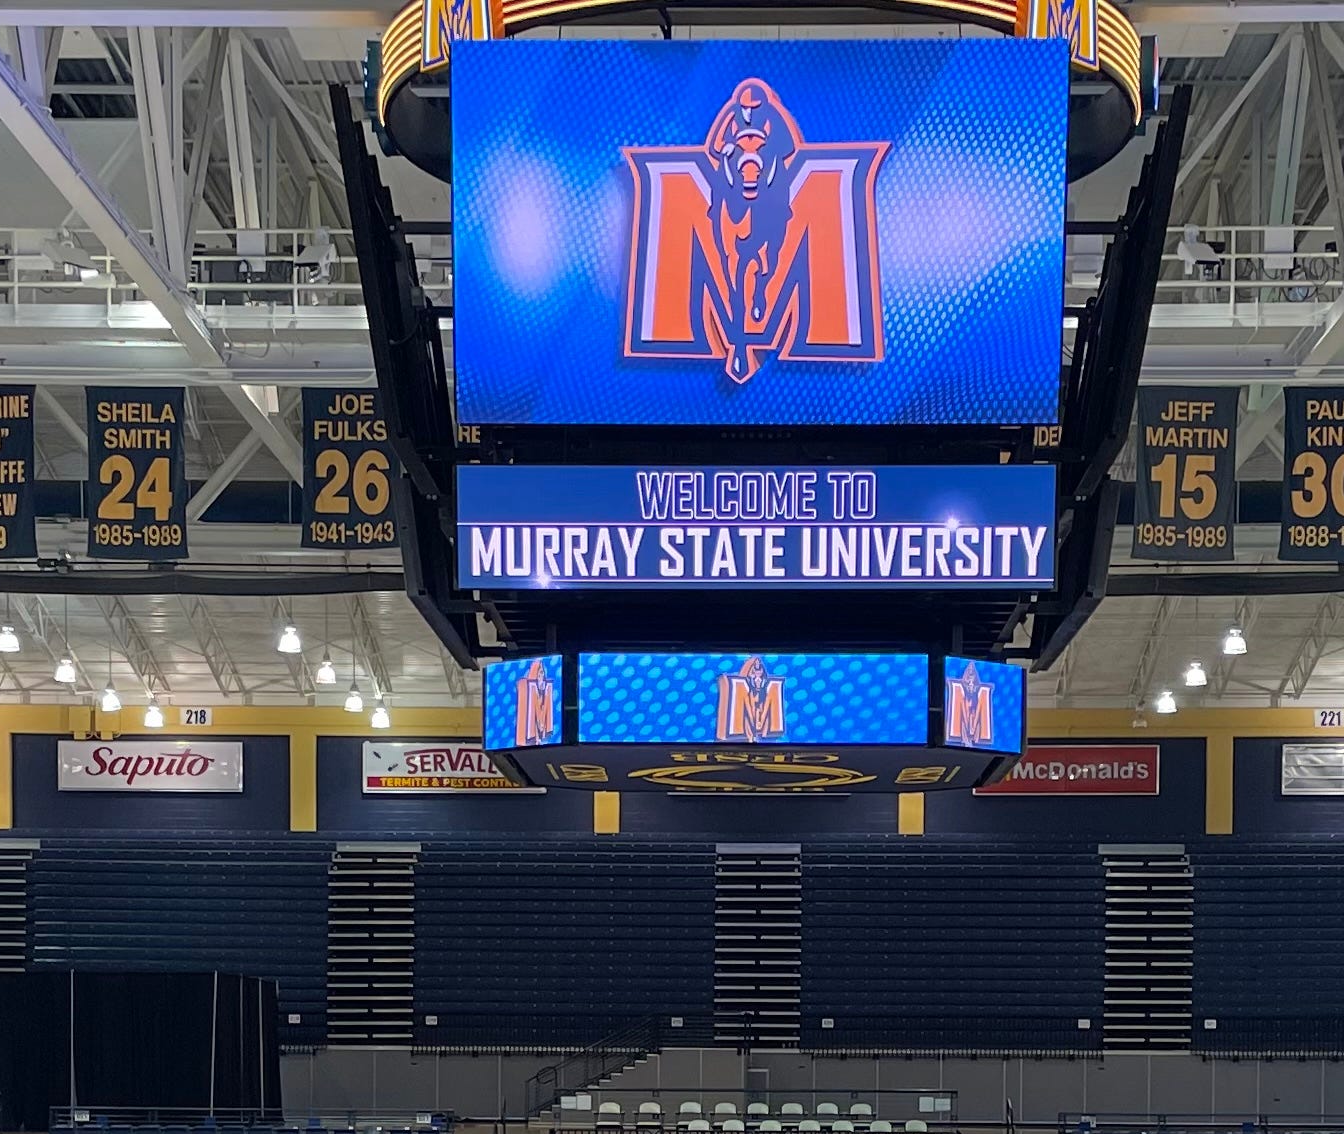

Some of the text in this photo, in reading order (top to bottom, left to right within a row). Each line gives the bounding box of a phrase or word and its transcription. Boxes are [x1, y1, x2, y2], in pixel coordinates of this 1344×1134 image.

[97, 401, 176, 423] SHEILA
[328, 394, 374, 415] JOE
[1161, 401, 1215, 422] JEFF
[104, 428, 171, 450] SMITH
[314, 420, 387, 441] FULKS
[1146, 426, 1228, 448] MARTIN
[97, 454, 172, 521] 24
[314, 449, 390, 516] 26
[1151, 454, 1218, 520] 15
[636, 472, 877, 520] WELCOME TO
[94, 525, 182, 546] 1985-1989
[310, 521, 395, 544] 1941-1943
[1137, 523, 1227, 548] 1985-1989
[471, 526, 1048, 578] MURRAY STATE UNIVERSITY
[186, 709, 206, 725] 218
[1320, 710, 1342, 727] 221
[85, 747, 215, 785] Saputo
[404, 748, 498, 775] SERVALL
[1012, 758, 1150, 783] McDonald's
[380, 778, 520, 788] TERMITE & PEST CONTR
